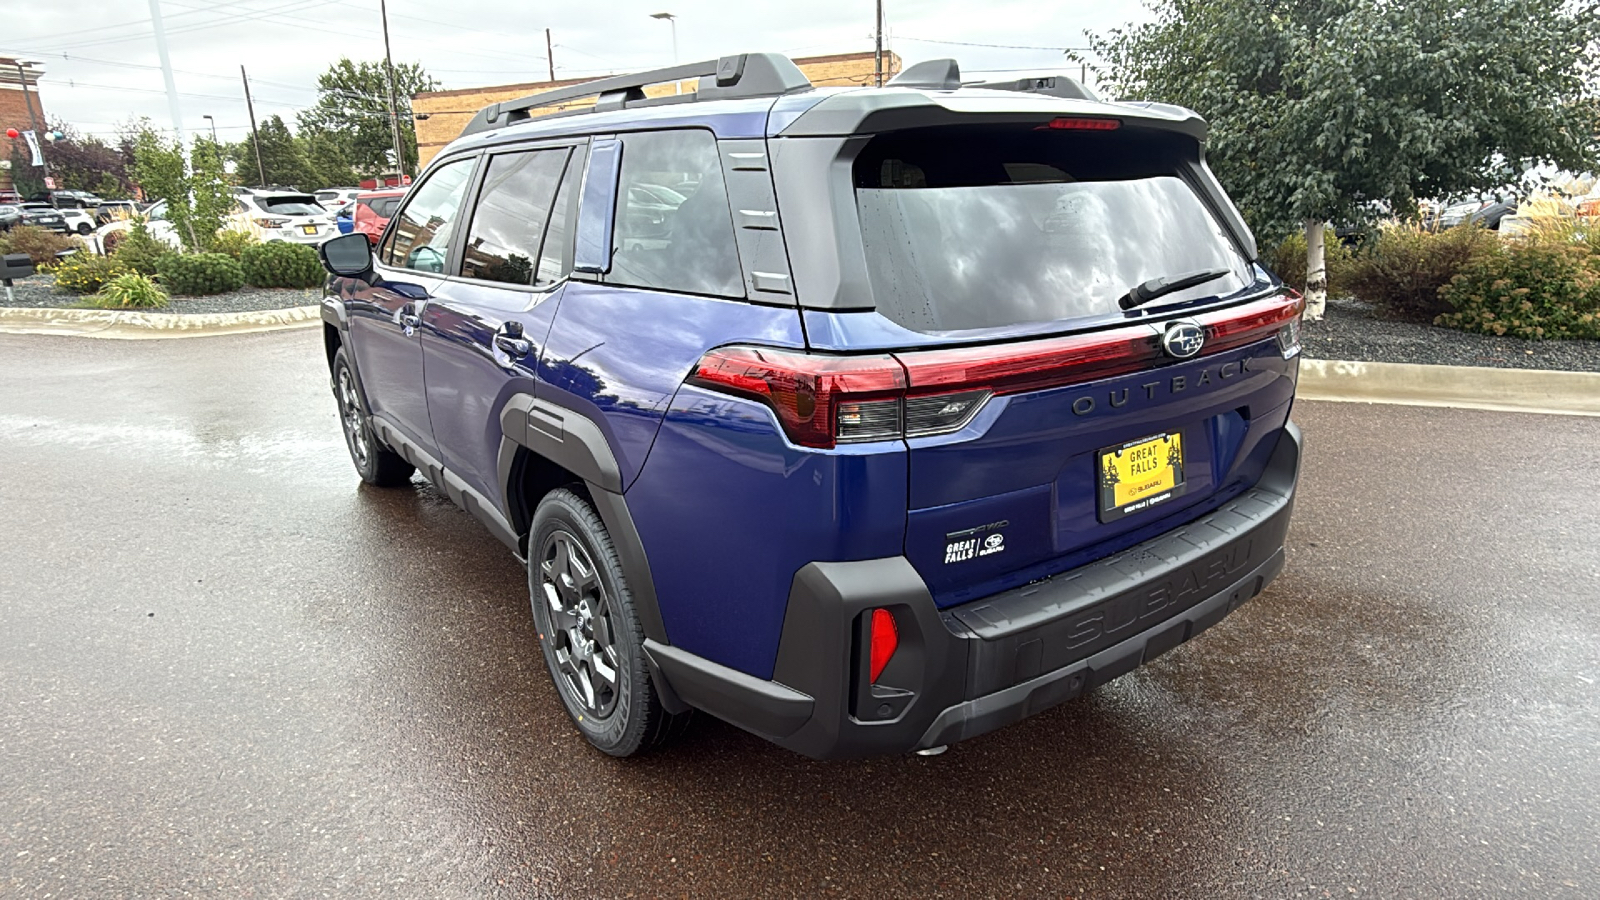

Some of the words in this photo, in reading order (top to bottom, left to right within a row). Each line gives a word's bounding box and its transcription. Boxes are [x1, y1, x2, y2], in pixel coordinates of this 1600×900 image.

[1072, 357, 1253, 416] OUTBACK
[1130, 445, 1157, 463] GREAT
[1130, 457, 1158, 476] FALLS
[946, 538, 976, 553] GREAT
[944, 548, 974, 564] FALLS
[1066, 540, 1253, 650] SUBARU
